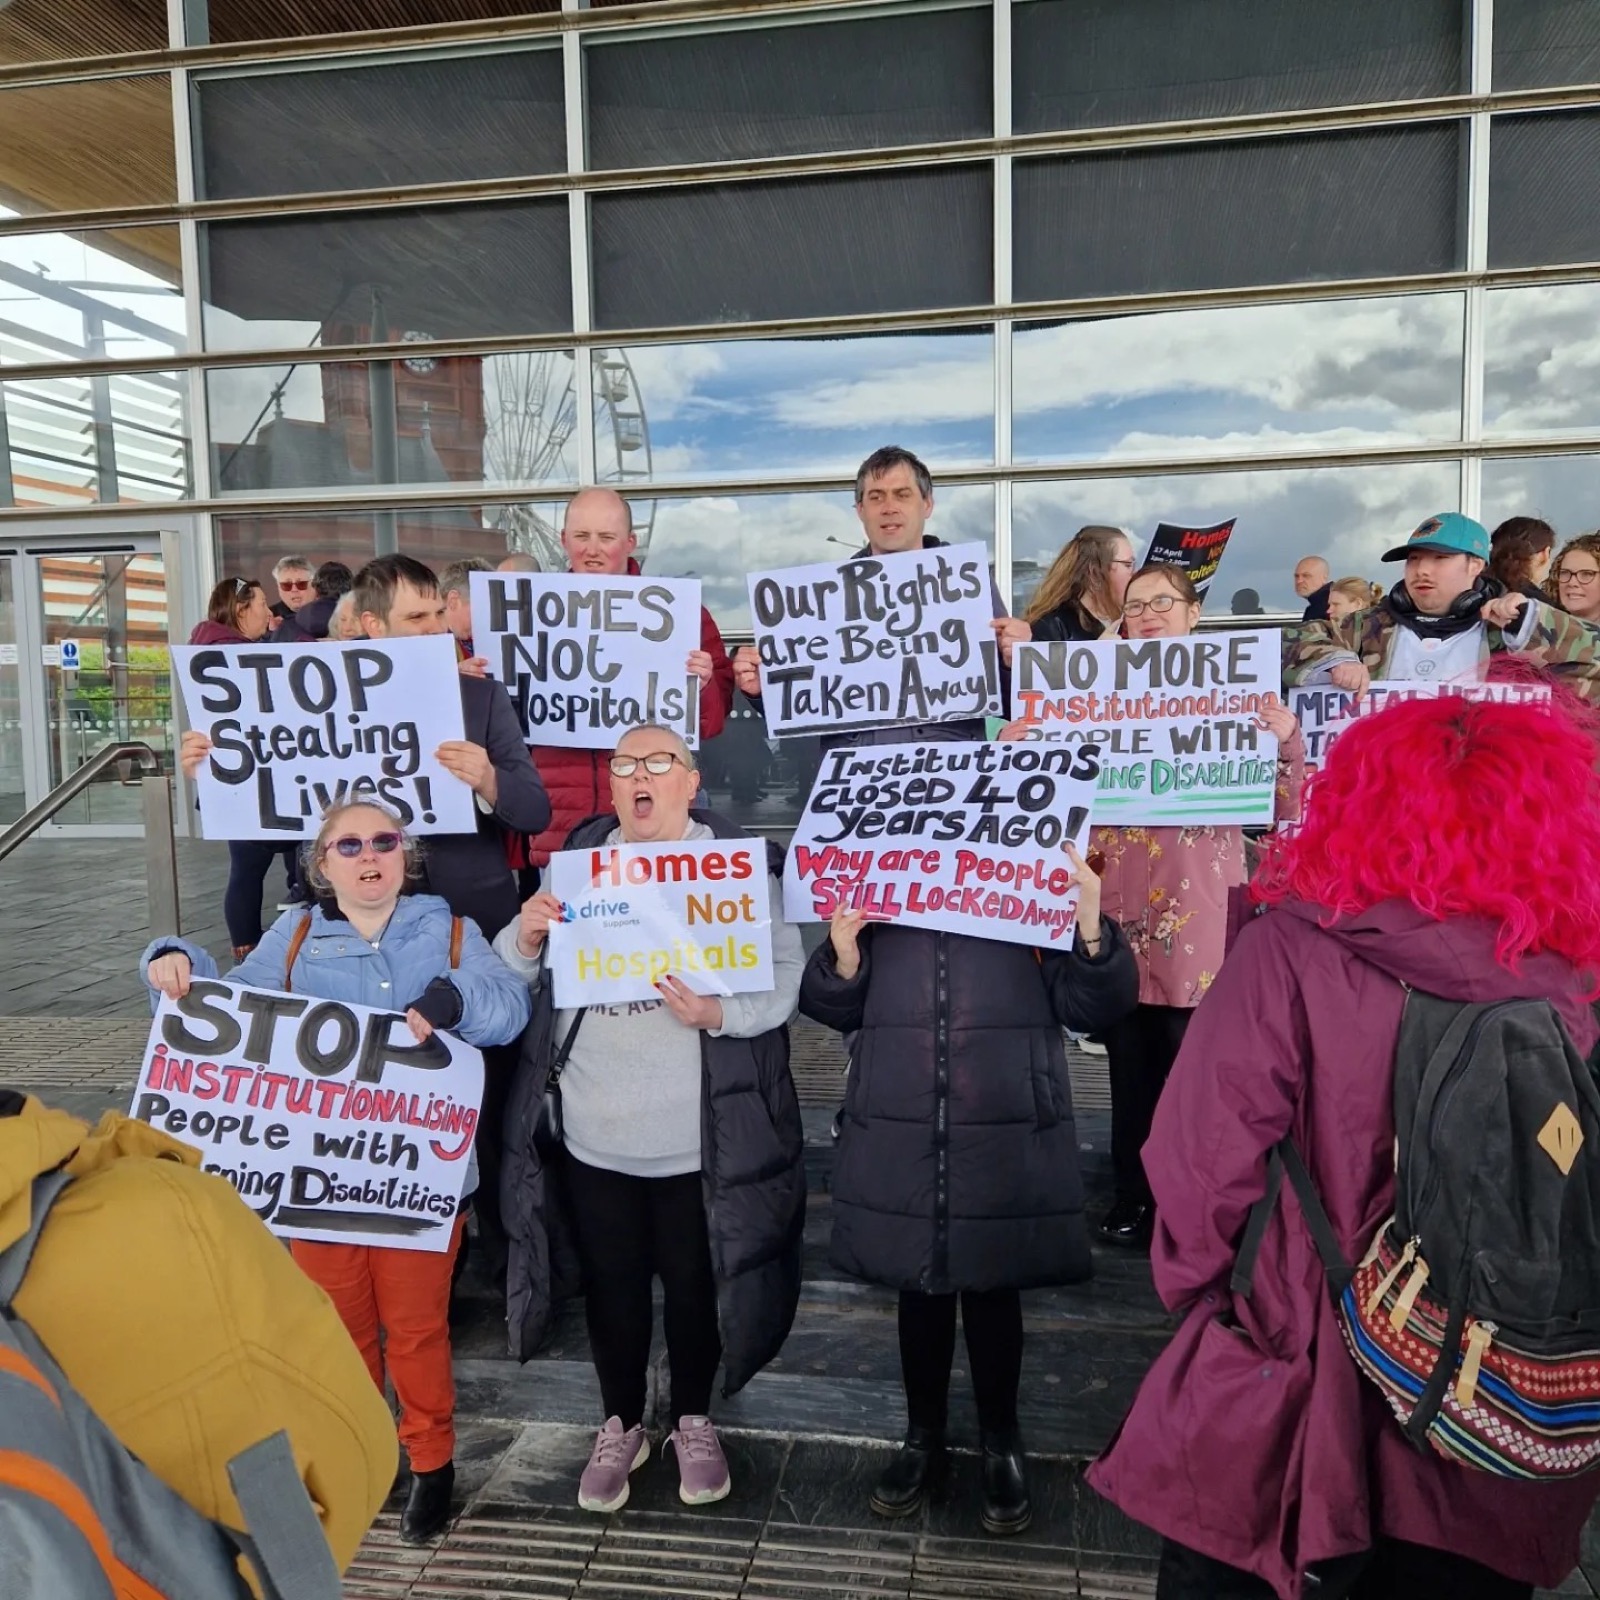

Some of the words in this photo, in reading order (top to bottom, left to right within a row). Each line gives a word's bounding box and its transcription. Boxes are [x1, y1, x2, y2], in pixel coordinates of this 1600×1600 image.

[1163, 548, 1183, 558] April
[1181, 526, 1231, 548] Homes
[754, 578, 839, 627] Our
[836, 555, 982, 637] Rights
[500, 631, 622, 686] Not
[758, 634, 829, 667] are
[836, 619, 970, 668] Being
[1019, 641, 1099, 690] NO
[1114, 636, 1259, 690] MORE
[189, 649, 393, 714] STOP
[767, 665, 890, 721] Taken
[897, 641, 999, 721] Away!
[485, 671, 699, 745] Hospitals!
[209, 711, 420, 784] Stealing
[257, 767, 437, 831] Lives!
[963, 775, 1056, 813] 40
[812, 806, 967, 843] years
[966, 806, 1090, 852] AGO!
[591, 849, 753, 889] Homes
[794, 845, 878, 883] Why
[878, 849, 940, 874] are
[955, 850, 1073, 896] People
[580, 899, 630, 919] drive
[686, 893, 756, 925] Not
[577, 935, 759, 984] Hospitals
[161, 980, 452, 1084] STOP
[136, 1092, 290, 1150] People
[313, 1130, 419, 1170] with
[289, 1165, 455, 1218] Disabilities
